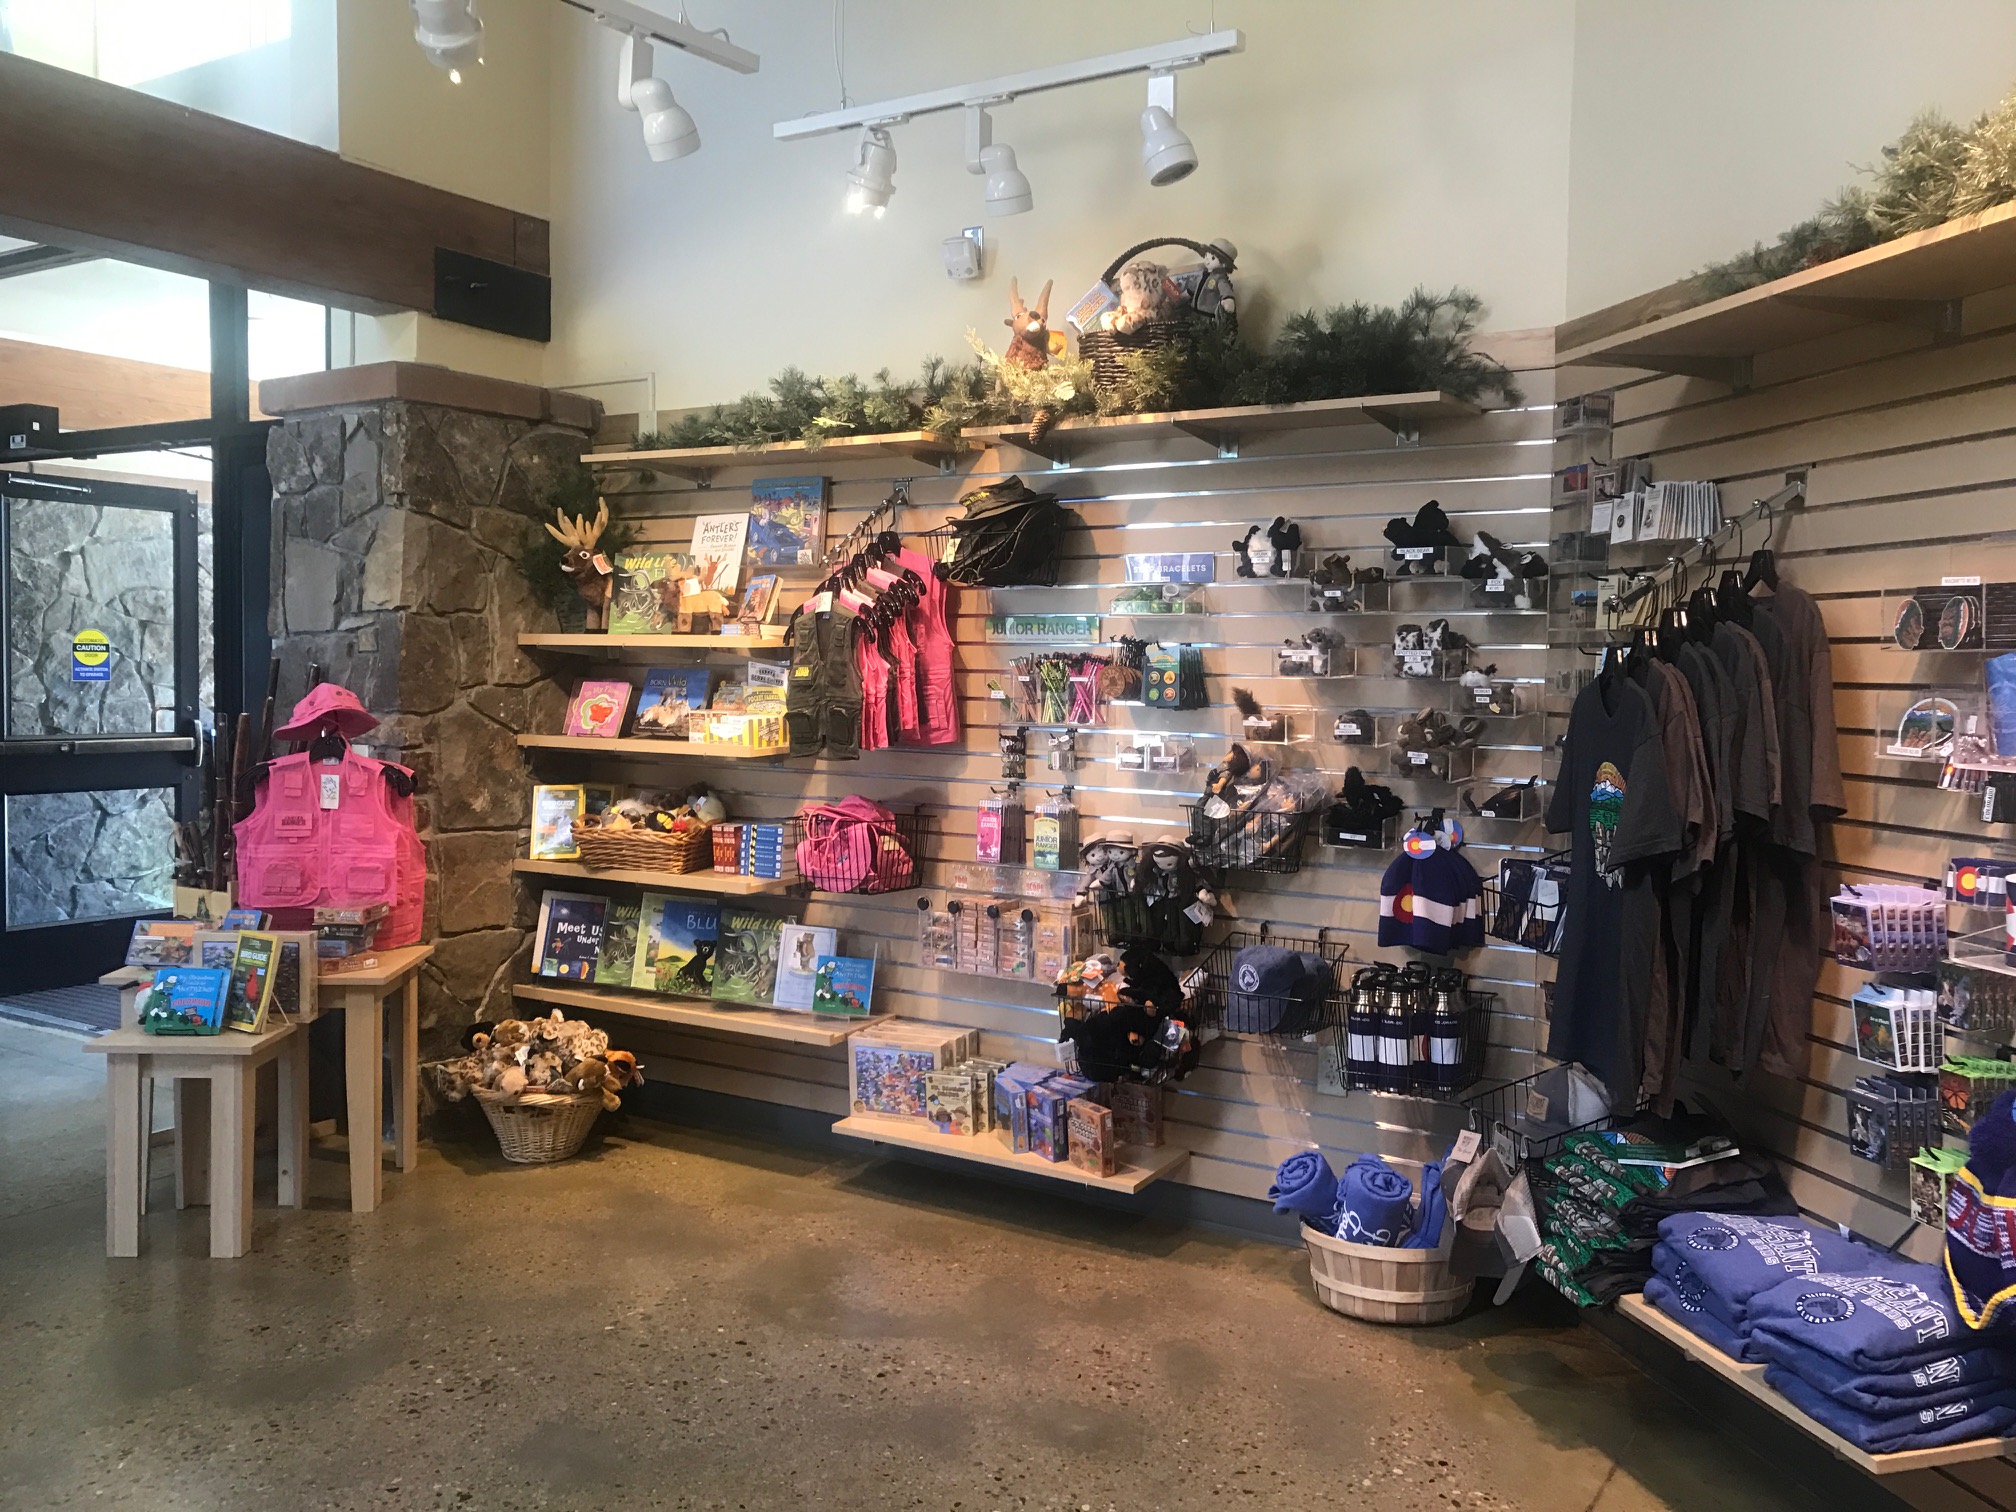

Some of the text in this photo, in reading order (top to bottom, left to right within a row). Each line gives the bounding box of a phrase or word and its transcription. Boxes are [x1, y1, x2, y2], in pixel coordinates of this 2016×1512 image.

[702, 521, 740, 534] ANTLERS
[701, 533, 738, 544] FOREVER!
[624, 556, 676, 569] Wild Lie
[991, 621, 1093, 636] JUNIOR RANGER
[1036, 835, 1058, 843] JUNIOR
[556, 921, 587, 935] Meet
[686, 914, 717, 931] BLU
[730, 915, 760, 931] Wild
[576, 934, 600, 946] Under
[1806, 1291, 1840, 1299] NATIONAL
